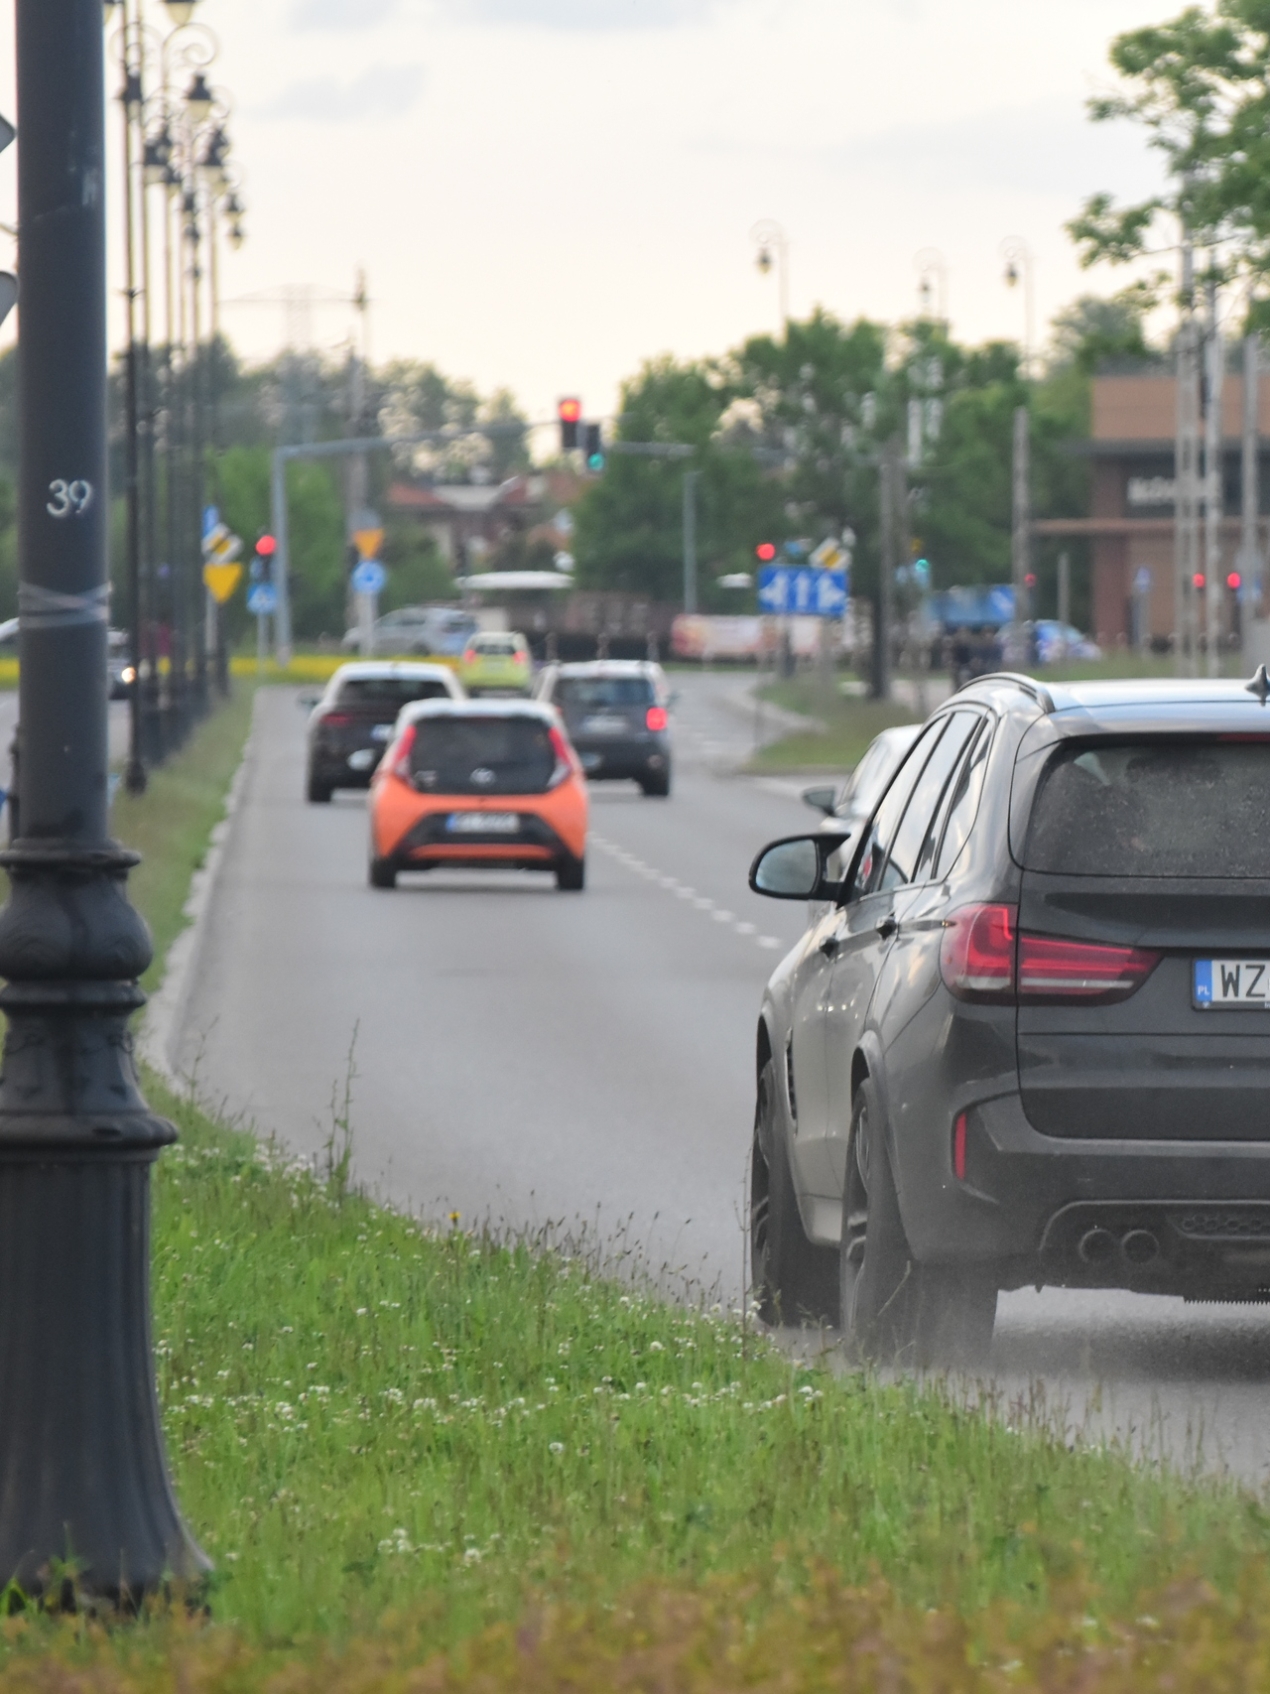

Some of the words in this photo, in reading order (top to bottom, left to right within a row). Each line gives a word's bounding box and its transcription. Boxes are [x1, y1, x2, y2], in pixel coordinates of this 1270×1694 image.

[46, 478, 92, 516] 39
[1198, 985, 1210, 996] PL
[1220, 964, 1266, 998] WZ
